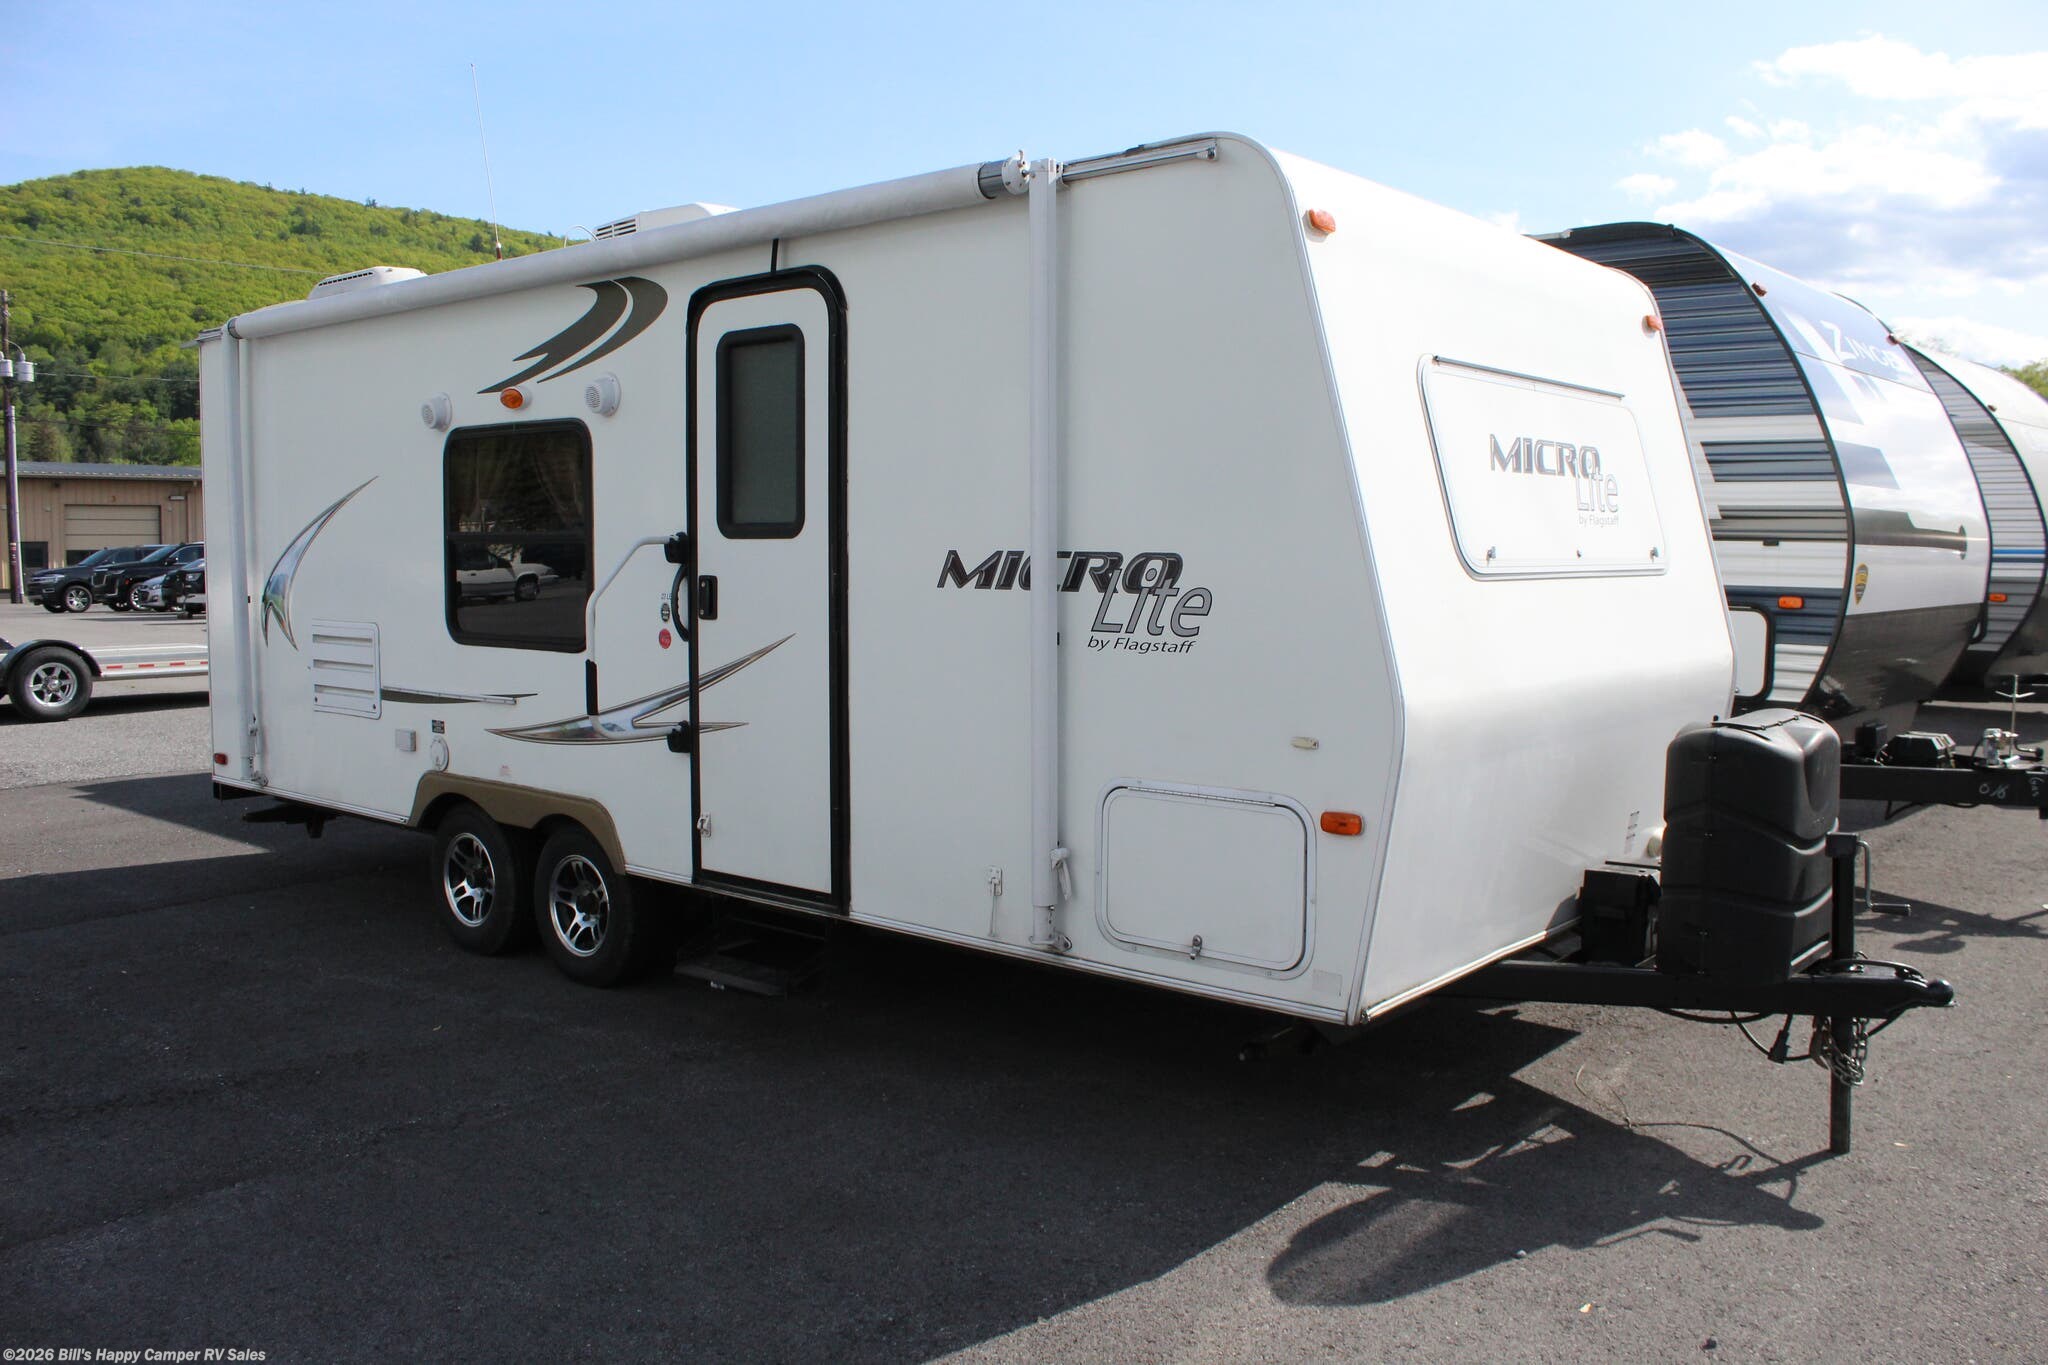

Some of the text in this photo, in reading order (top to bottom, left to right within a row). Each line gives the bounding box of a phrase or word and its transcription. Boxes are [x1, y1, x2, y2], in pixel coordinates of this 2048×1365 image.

[1489, 433, 1601, 479] MICRO
[1574, 457, 1619, 513] Lite
[1091, 568, 1214, 638] Lite
[1087, 636, 1110, 651] by
[1113, 637, 1197, 655] Flagstaff
